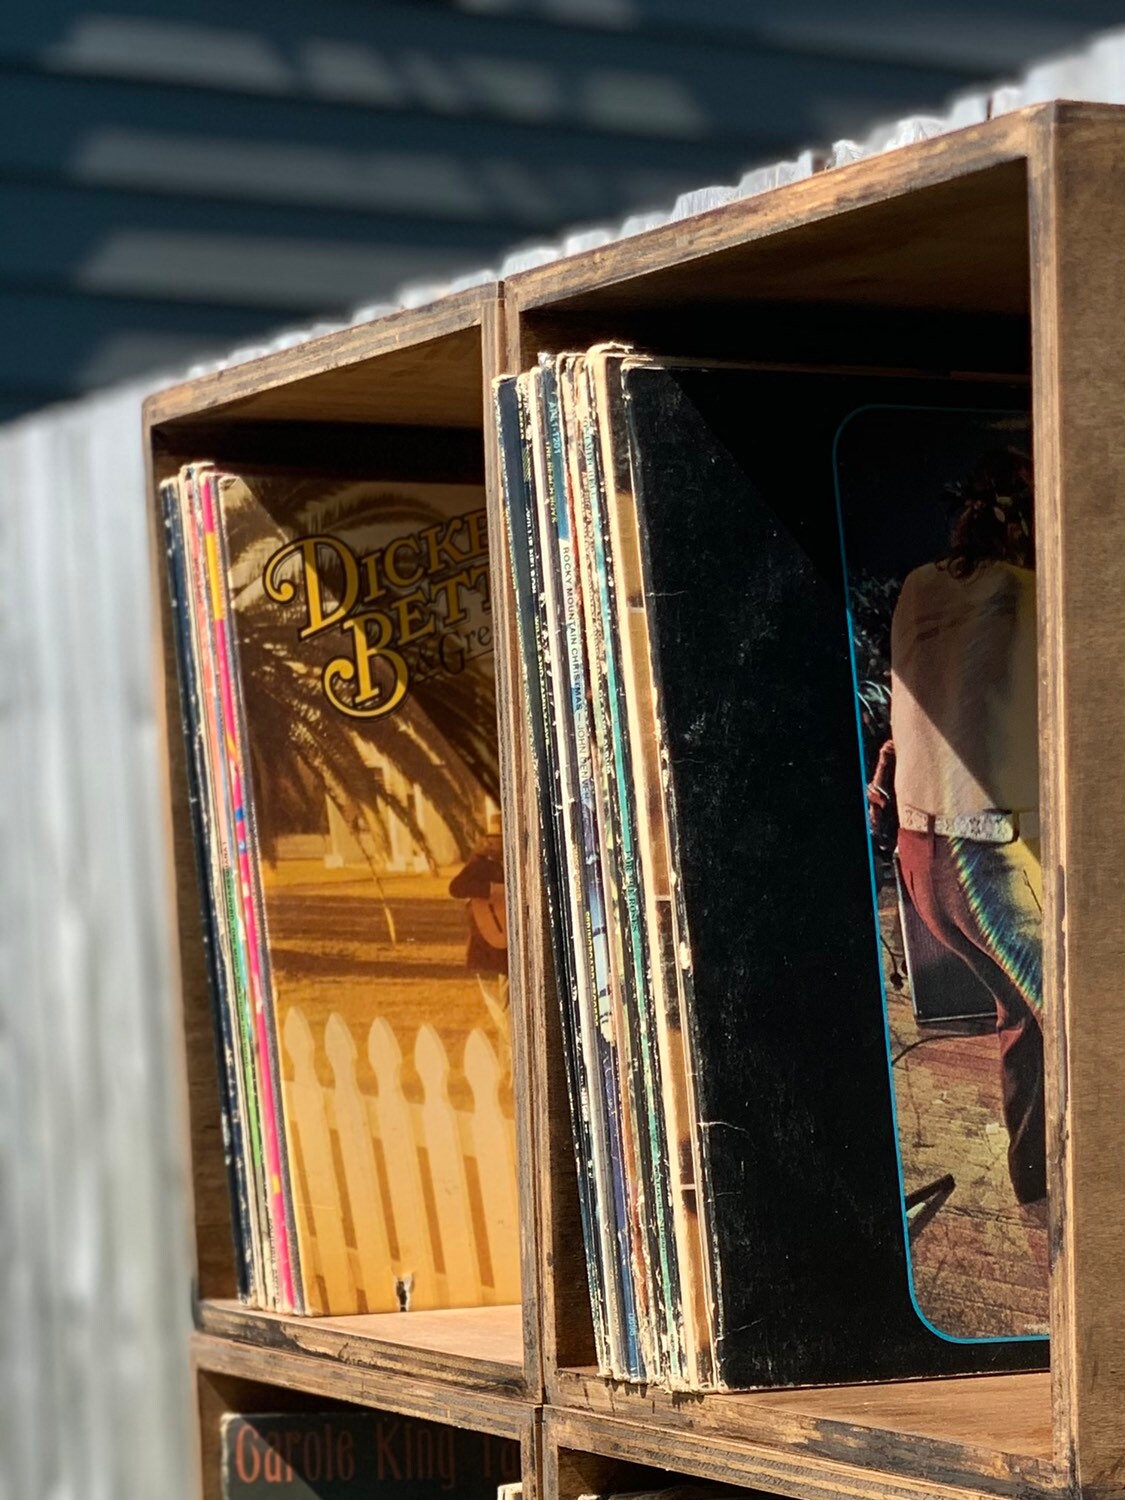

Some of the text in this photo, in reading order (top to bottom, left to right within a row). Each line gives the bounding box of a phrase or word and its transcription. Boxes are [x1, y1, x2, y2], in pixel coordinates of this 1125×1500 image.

[563, 547, 590, 799] ROCKY MOUNTAIN CHRISTMAS JOHN DENVER
[235, 1422, 356, 1484] Carole
[374, 1420, 457, 1491] King
